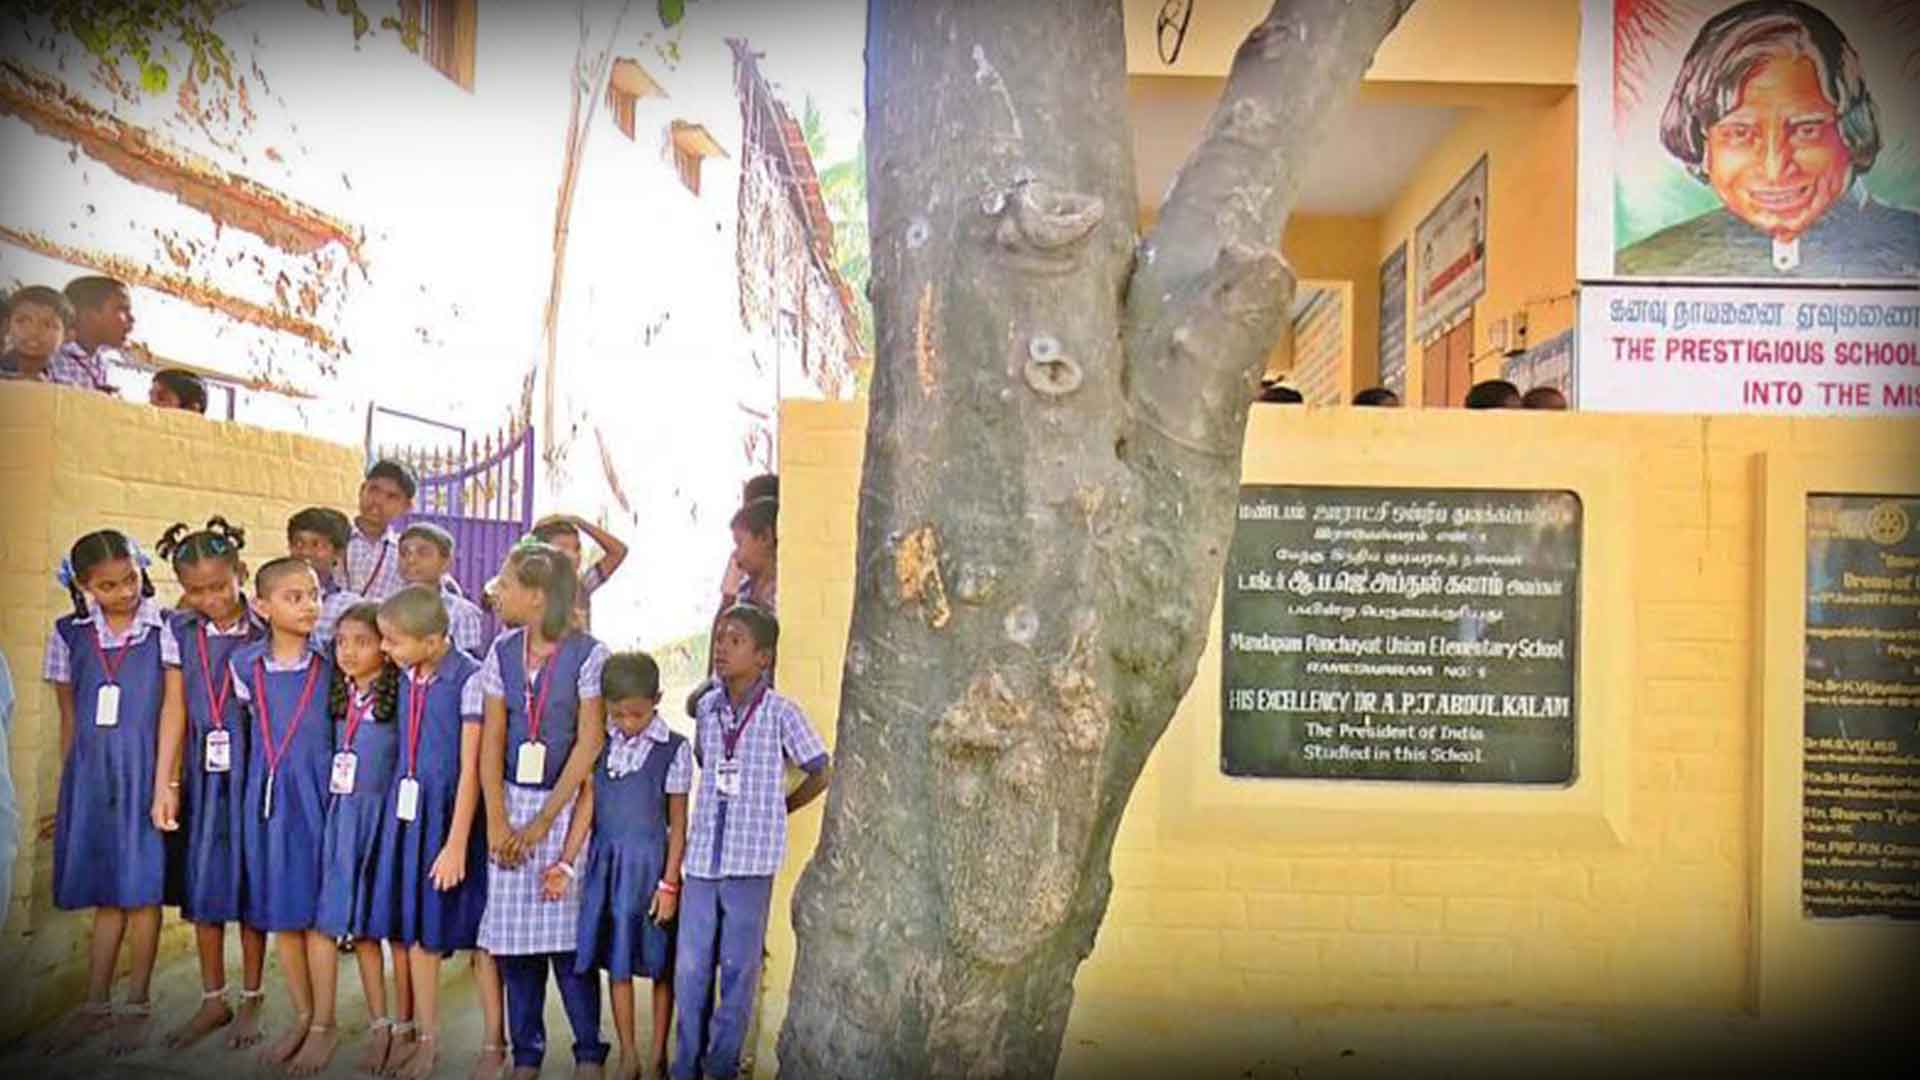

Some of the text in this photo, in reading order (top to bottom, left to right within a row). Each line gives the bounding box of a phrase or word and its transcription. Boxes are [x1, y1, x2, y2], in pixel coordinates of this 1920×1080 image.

[1612, 337, 1656, 361] THE
[1665, 338, 1825, 364] PRESTIGIOUS
[1743, 380, 1803, 406] INTO
[1817, 382, 1871, 407] THE
[1230, 632, 1565, 660] Mandapam Panchayat Union Elementary School
[1229, 689, 1254, 711] HIS
[1257, 688, 1351, 713] EXCELLENCY
[1306, 721, 1485, 741] The President of India
[1304, 743, 1483, 763] Studied in this School
